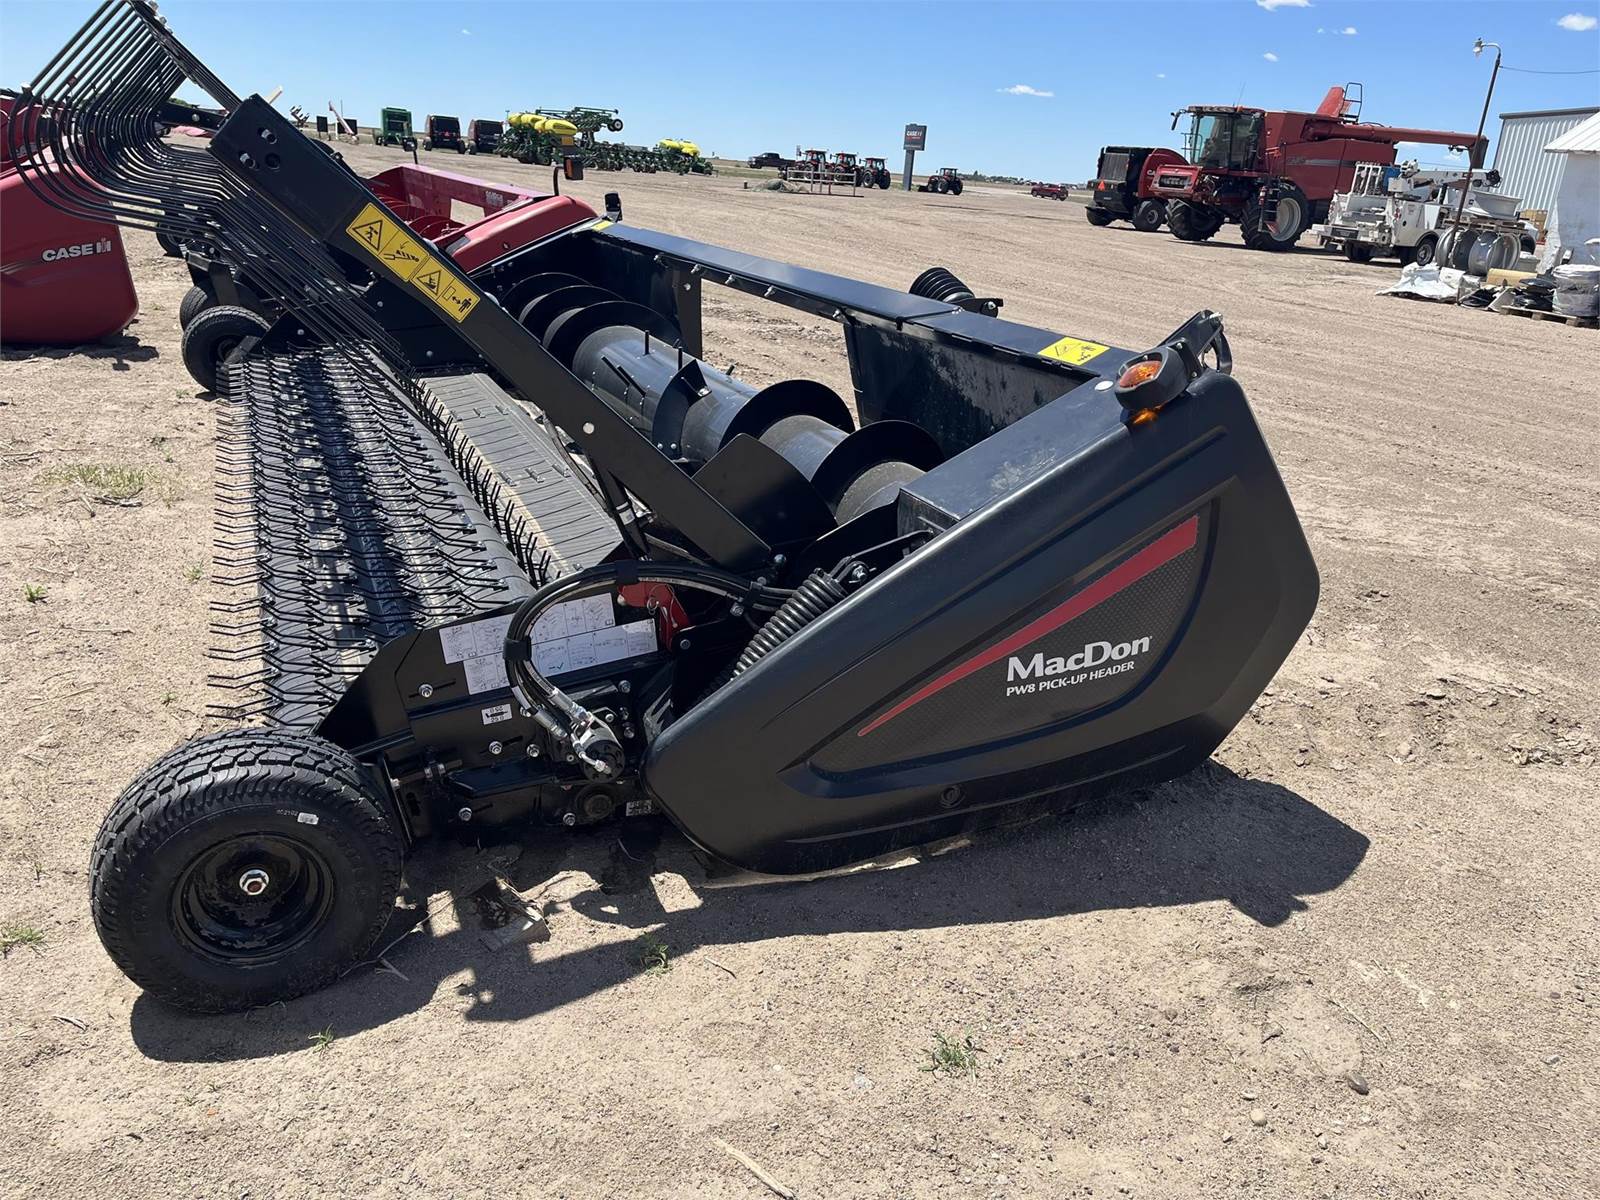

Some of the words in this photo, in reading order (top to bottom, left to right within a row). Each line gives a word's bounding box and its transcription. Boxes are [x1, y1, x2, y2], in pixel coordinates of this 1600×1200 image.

[42, 243, 93, 261] CASE
[1007, 635, 1150, 682] MacDon
[1006, 683, 1036, 697] PW8
[1039, 673, 1088, 691] PICK-UP
[1089, 660, 1135, 681] HEADER
